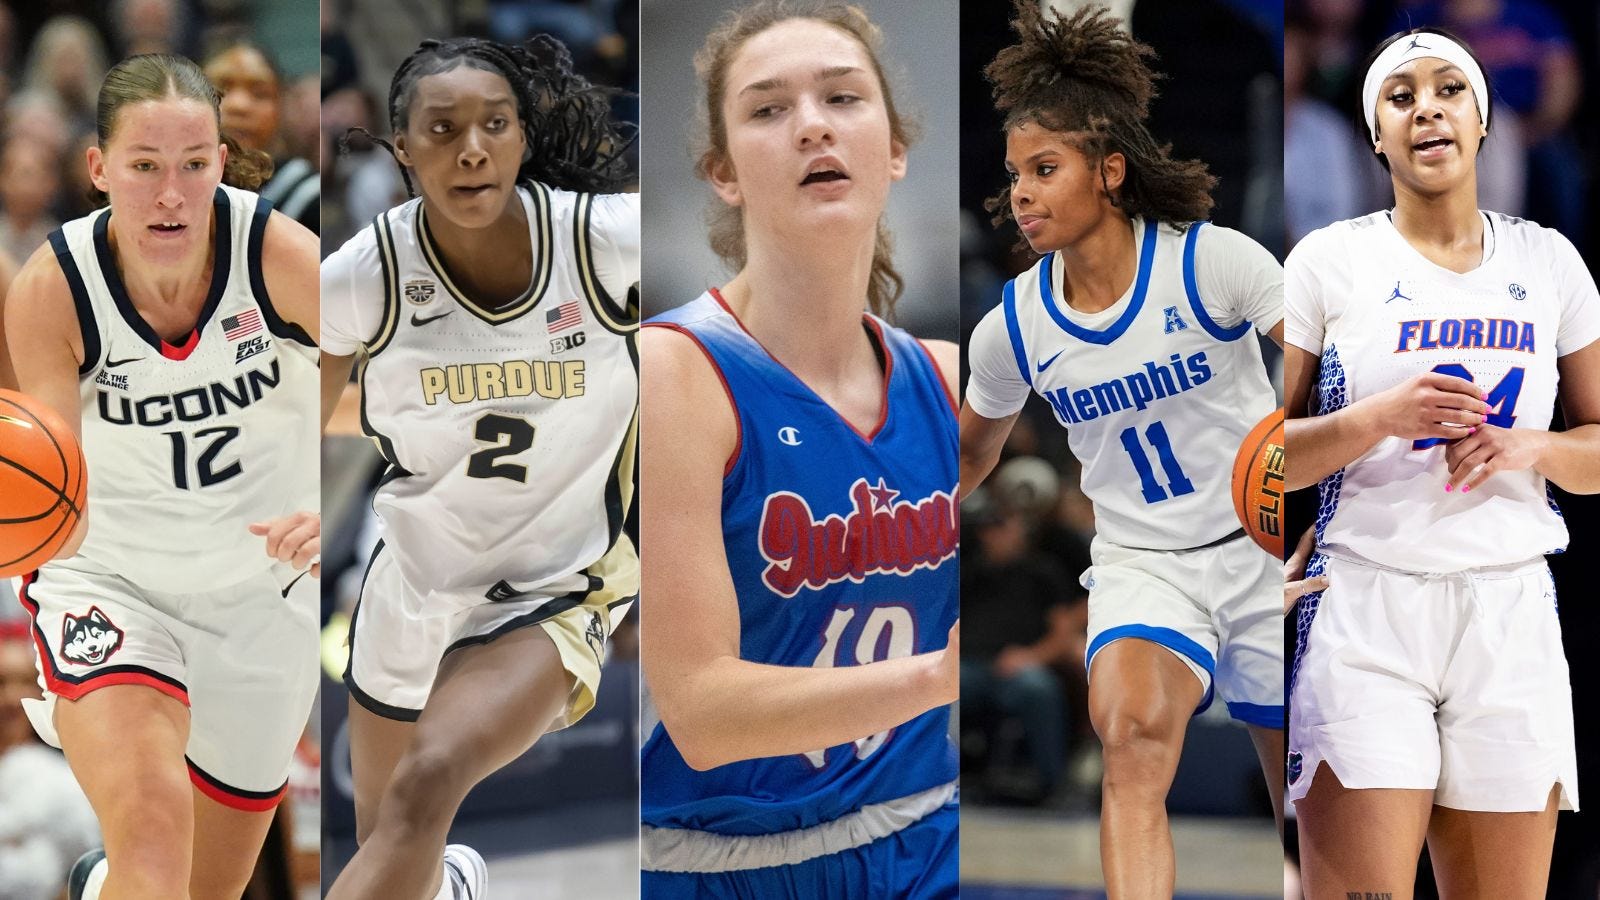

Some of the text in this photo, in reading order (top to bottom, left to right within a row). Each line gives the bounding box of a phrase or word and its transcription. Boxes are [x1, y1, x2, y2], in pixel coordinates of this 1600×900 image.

[405, 284, 436, 296] 25
[1509, 283, 1527, 301] SEC
[236, 340, 271, 360] EAST
[237, 335, 263, 351] BIG
[1393, 319, 1536, 354] FLORIDA
[95, 376, 129, 391] CHANGE
[97, 356, 281, 426] UCONN
[100, 369, 128, 384] BE THE
[420, 360, 586, 405] PURDUE
[1043, 351, 1212, 425] Memphis
[161, 426, 243, 491] 12
[464, 410, 536, 484] 2
[1120, 420, 1195, 504] 11
[758, 477, 960, 598] Indian
